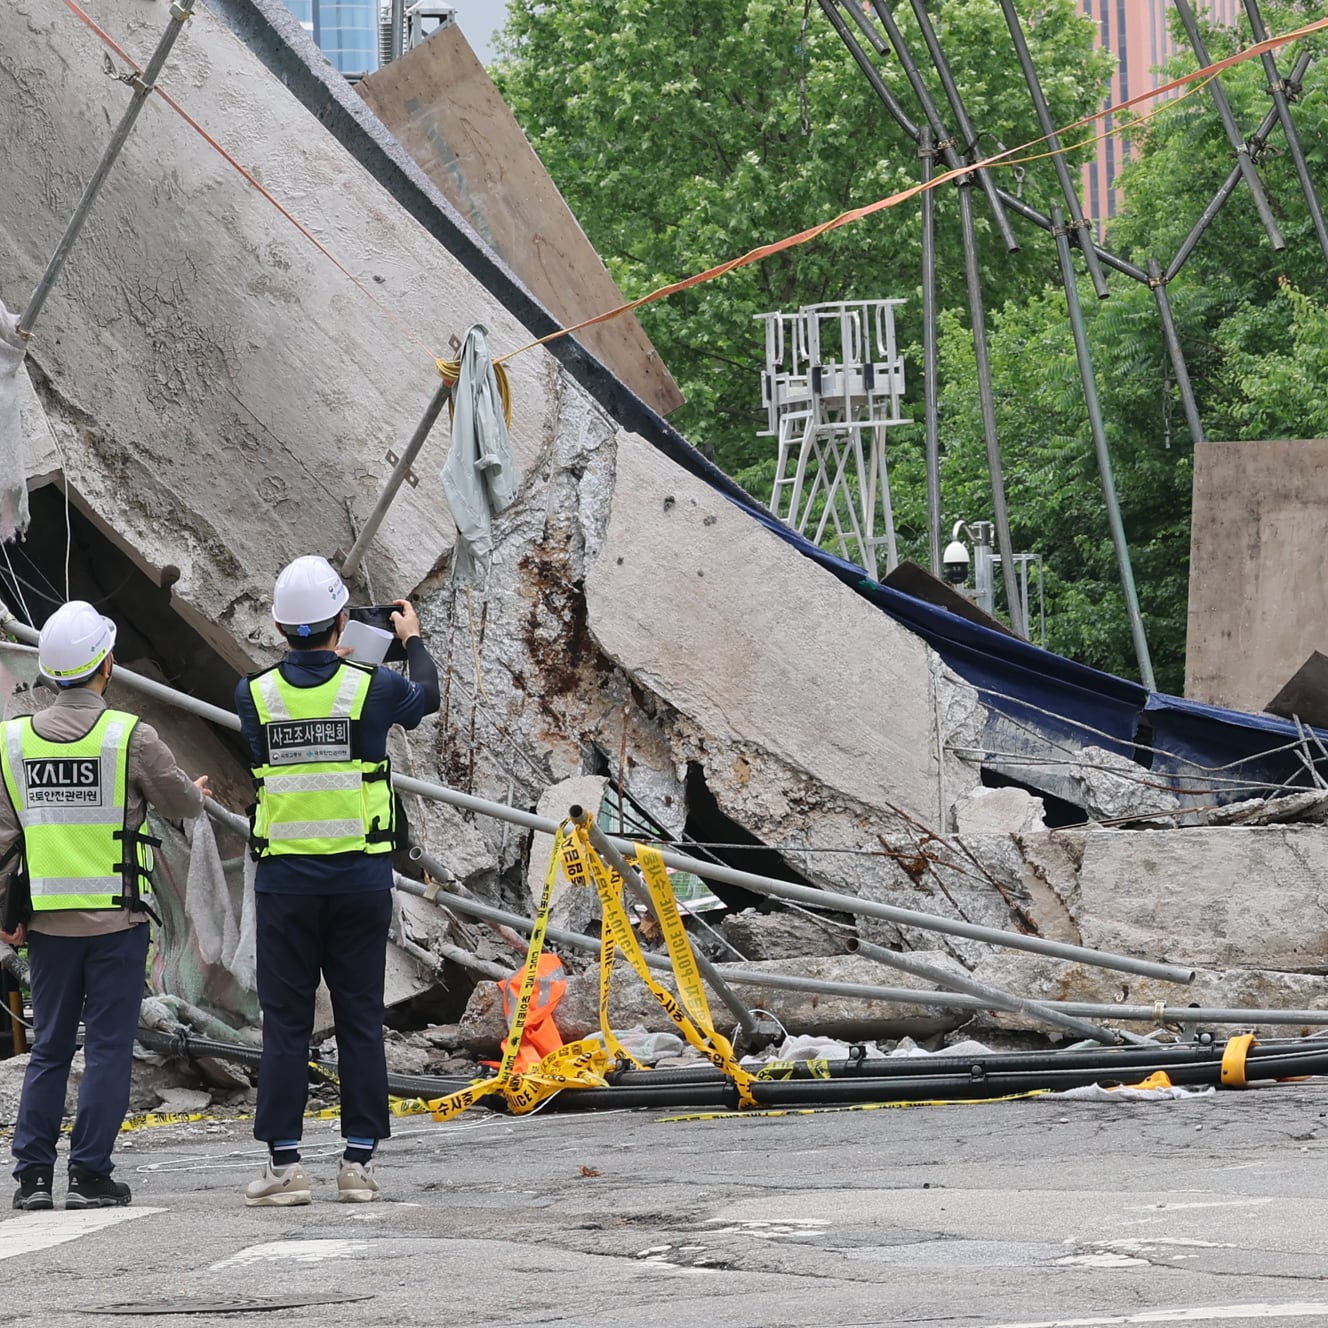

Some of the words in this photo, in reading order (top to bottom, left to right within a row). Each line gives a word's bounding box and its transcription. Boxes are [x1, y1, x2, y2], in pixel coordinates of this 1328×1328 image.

[272, 722, 346, 746] 사고조사위원회
[27, 762, 94, 785] KALIS
[28, 790, 97, 803] 국토안전관리원
